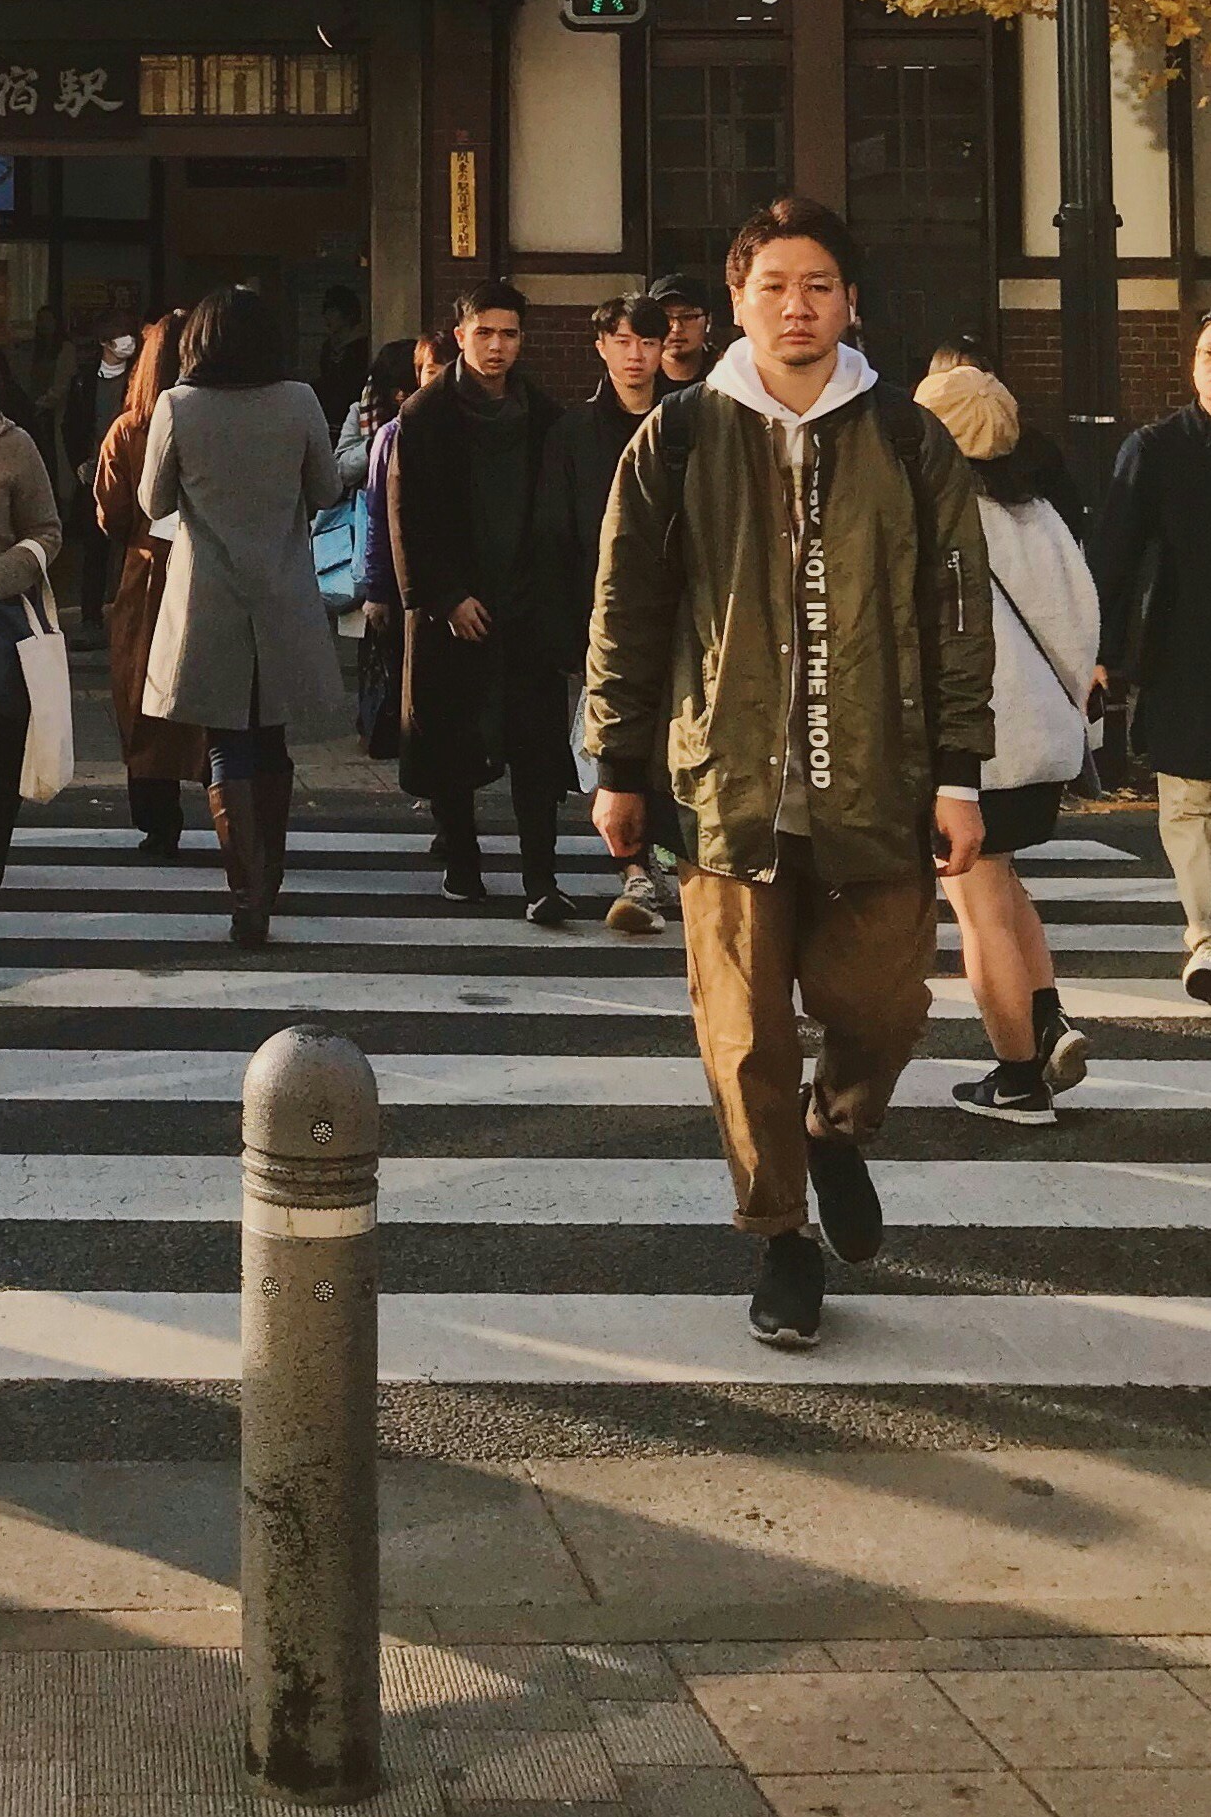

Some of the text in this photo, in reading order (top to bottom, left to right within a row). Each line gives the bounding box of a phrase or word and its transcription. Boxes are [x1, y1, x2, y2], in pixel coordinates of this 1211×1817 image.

[804, 538, 825, 595] NOT
[806, 602, 828, 631] IN
[808, 640, 828, 696] THE
[808, 704, 831, 790] MOOD
